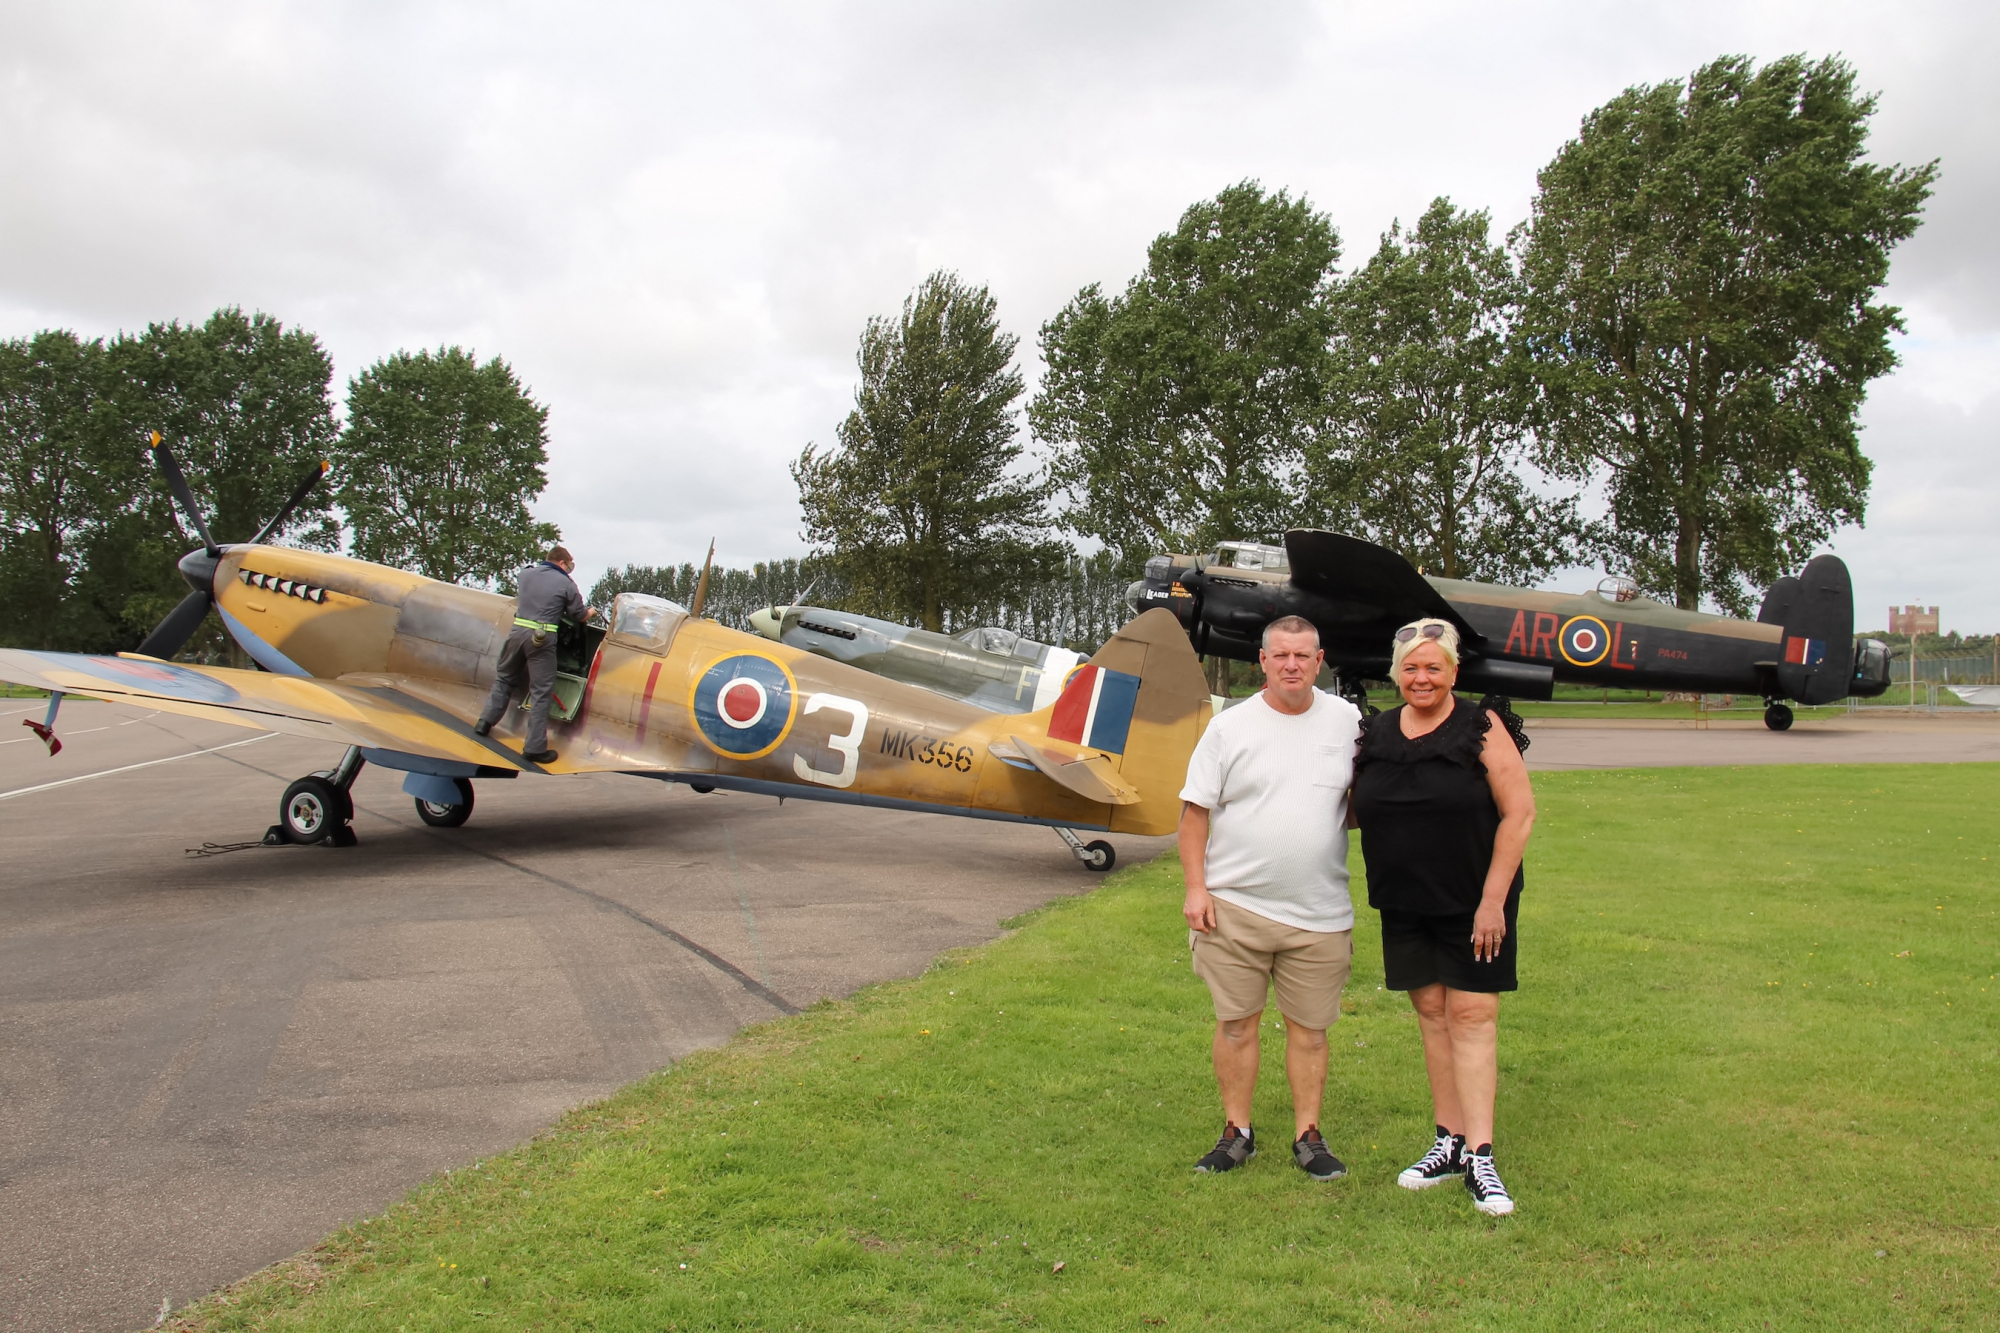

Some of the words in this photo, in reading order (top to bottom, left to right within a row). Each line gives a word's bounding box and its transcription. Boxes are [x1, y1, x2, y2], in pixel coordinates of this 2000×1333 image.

[1504, 609, 1559, 659] AR
[1610, 621, 1635, 670] L
[1658, 648, 1688, 660] PA474
[1015, 665, 1047, 701] F
[793, 692, 869, 789] 3
[880, 727, 974, 773] MK356
